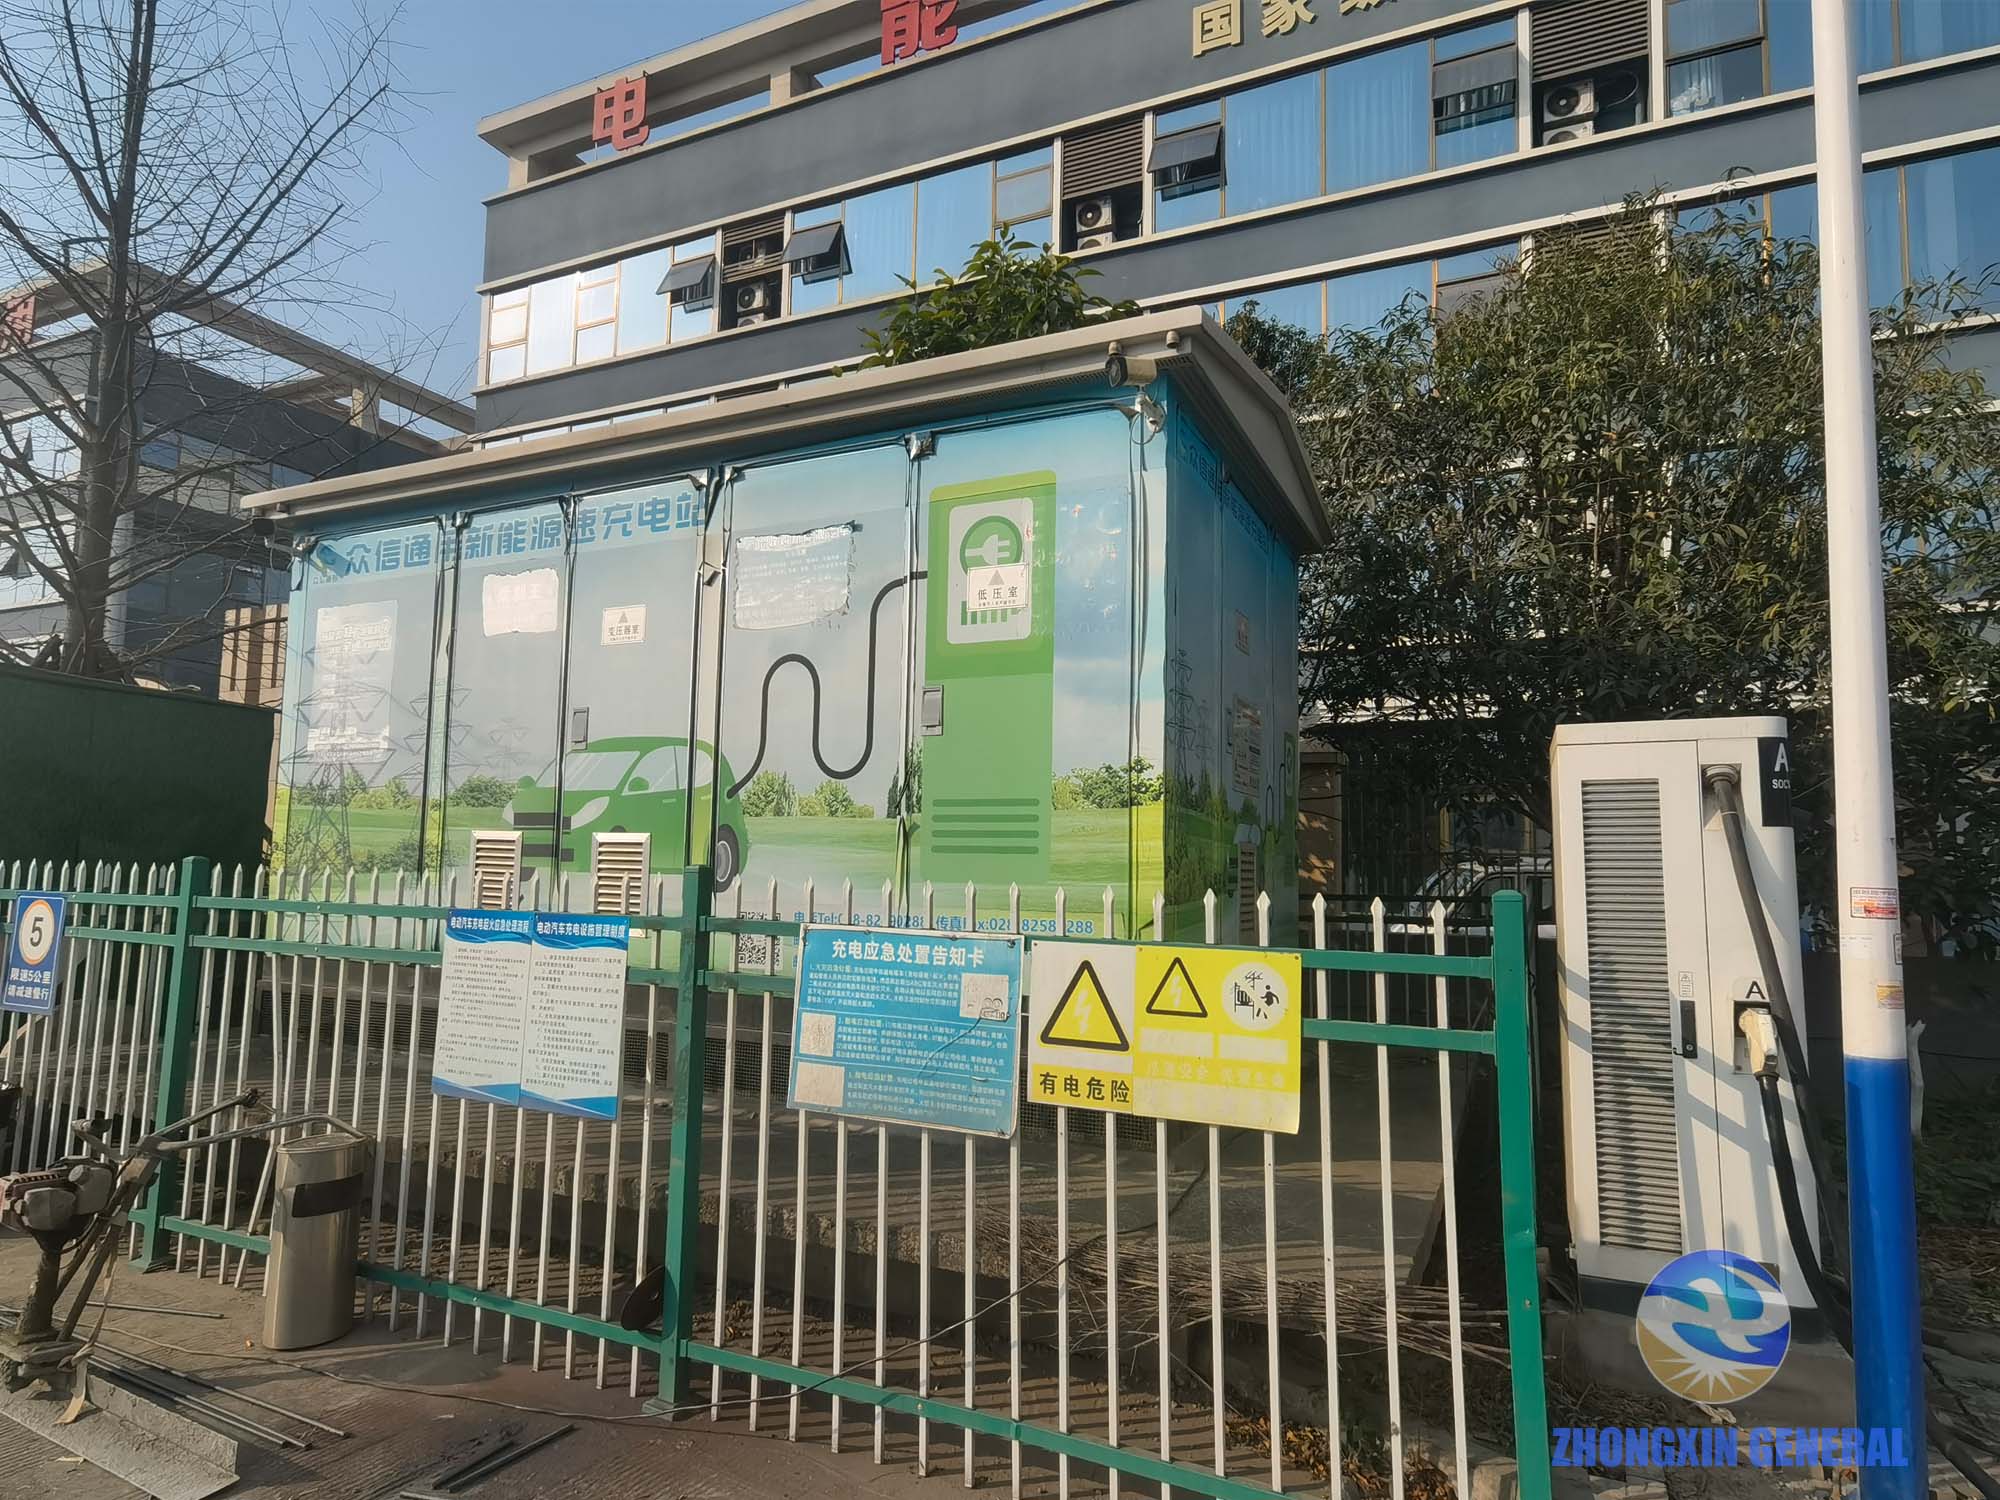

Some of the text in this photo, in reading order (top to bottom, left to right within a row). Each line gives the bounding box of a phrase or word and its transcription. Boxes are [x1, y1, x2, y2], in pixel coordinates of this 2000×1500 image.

[591, 74, 650, 152] 电
[978, 585, 1019, 601] 低压室
[1774, 742, 1789, 772] A
[30, 916, 44, 947] 5
[832, 938, 985, 968] 充电应急处置告知卡
[1745, 980, 1766, 1000] A
[1039, 1071, 1131, 1104] 有电危险
